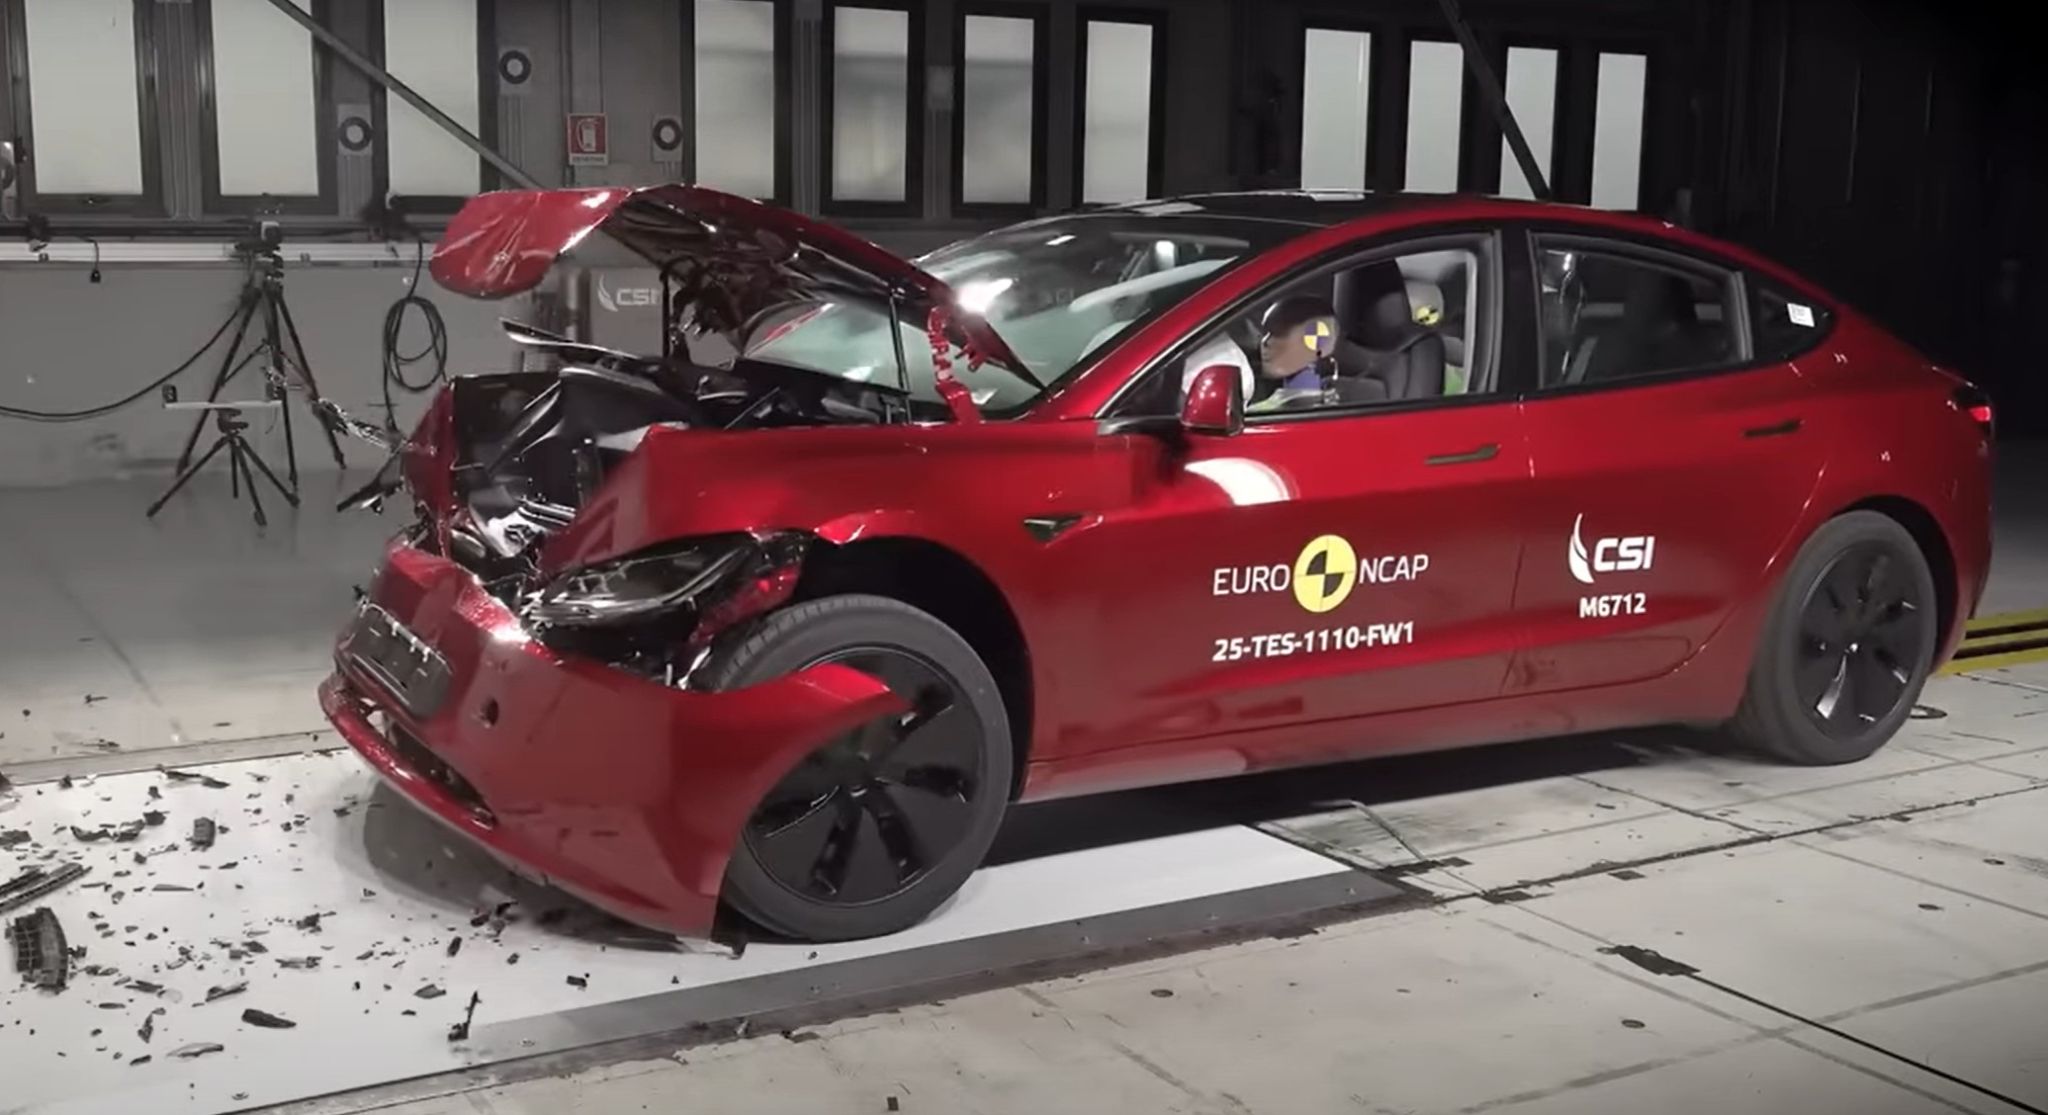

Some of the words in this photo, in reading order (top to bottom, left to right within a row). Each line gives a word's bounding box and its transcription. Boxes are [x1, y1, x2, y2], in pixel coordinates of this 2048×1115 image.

[617, 288, 657, 306] CSI
[1593, 537, 1655, 572] CSI
[1213, 565, 1291, 596] EURO
[1360, 554, 1429, 584] NCAP
[1580, 593, 1646, 618] M6712
[1213, 621, 1414, 661] 25-TES-1110-FW1
